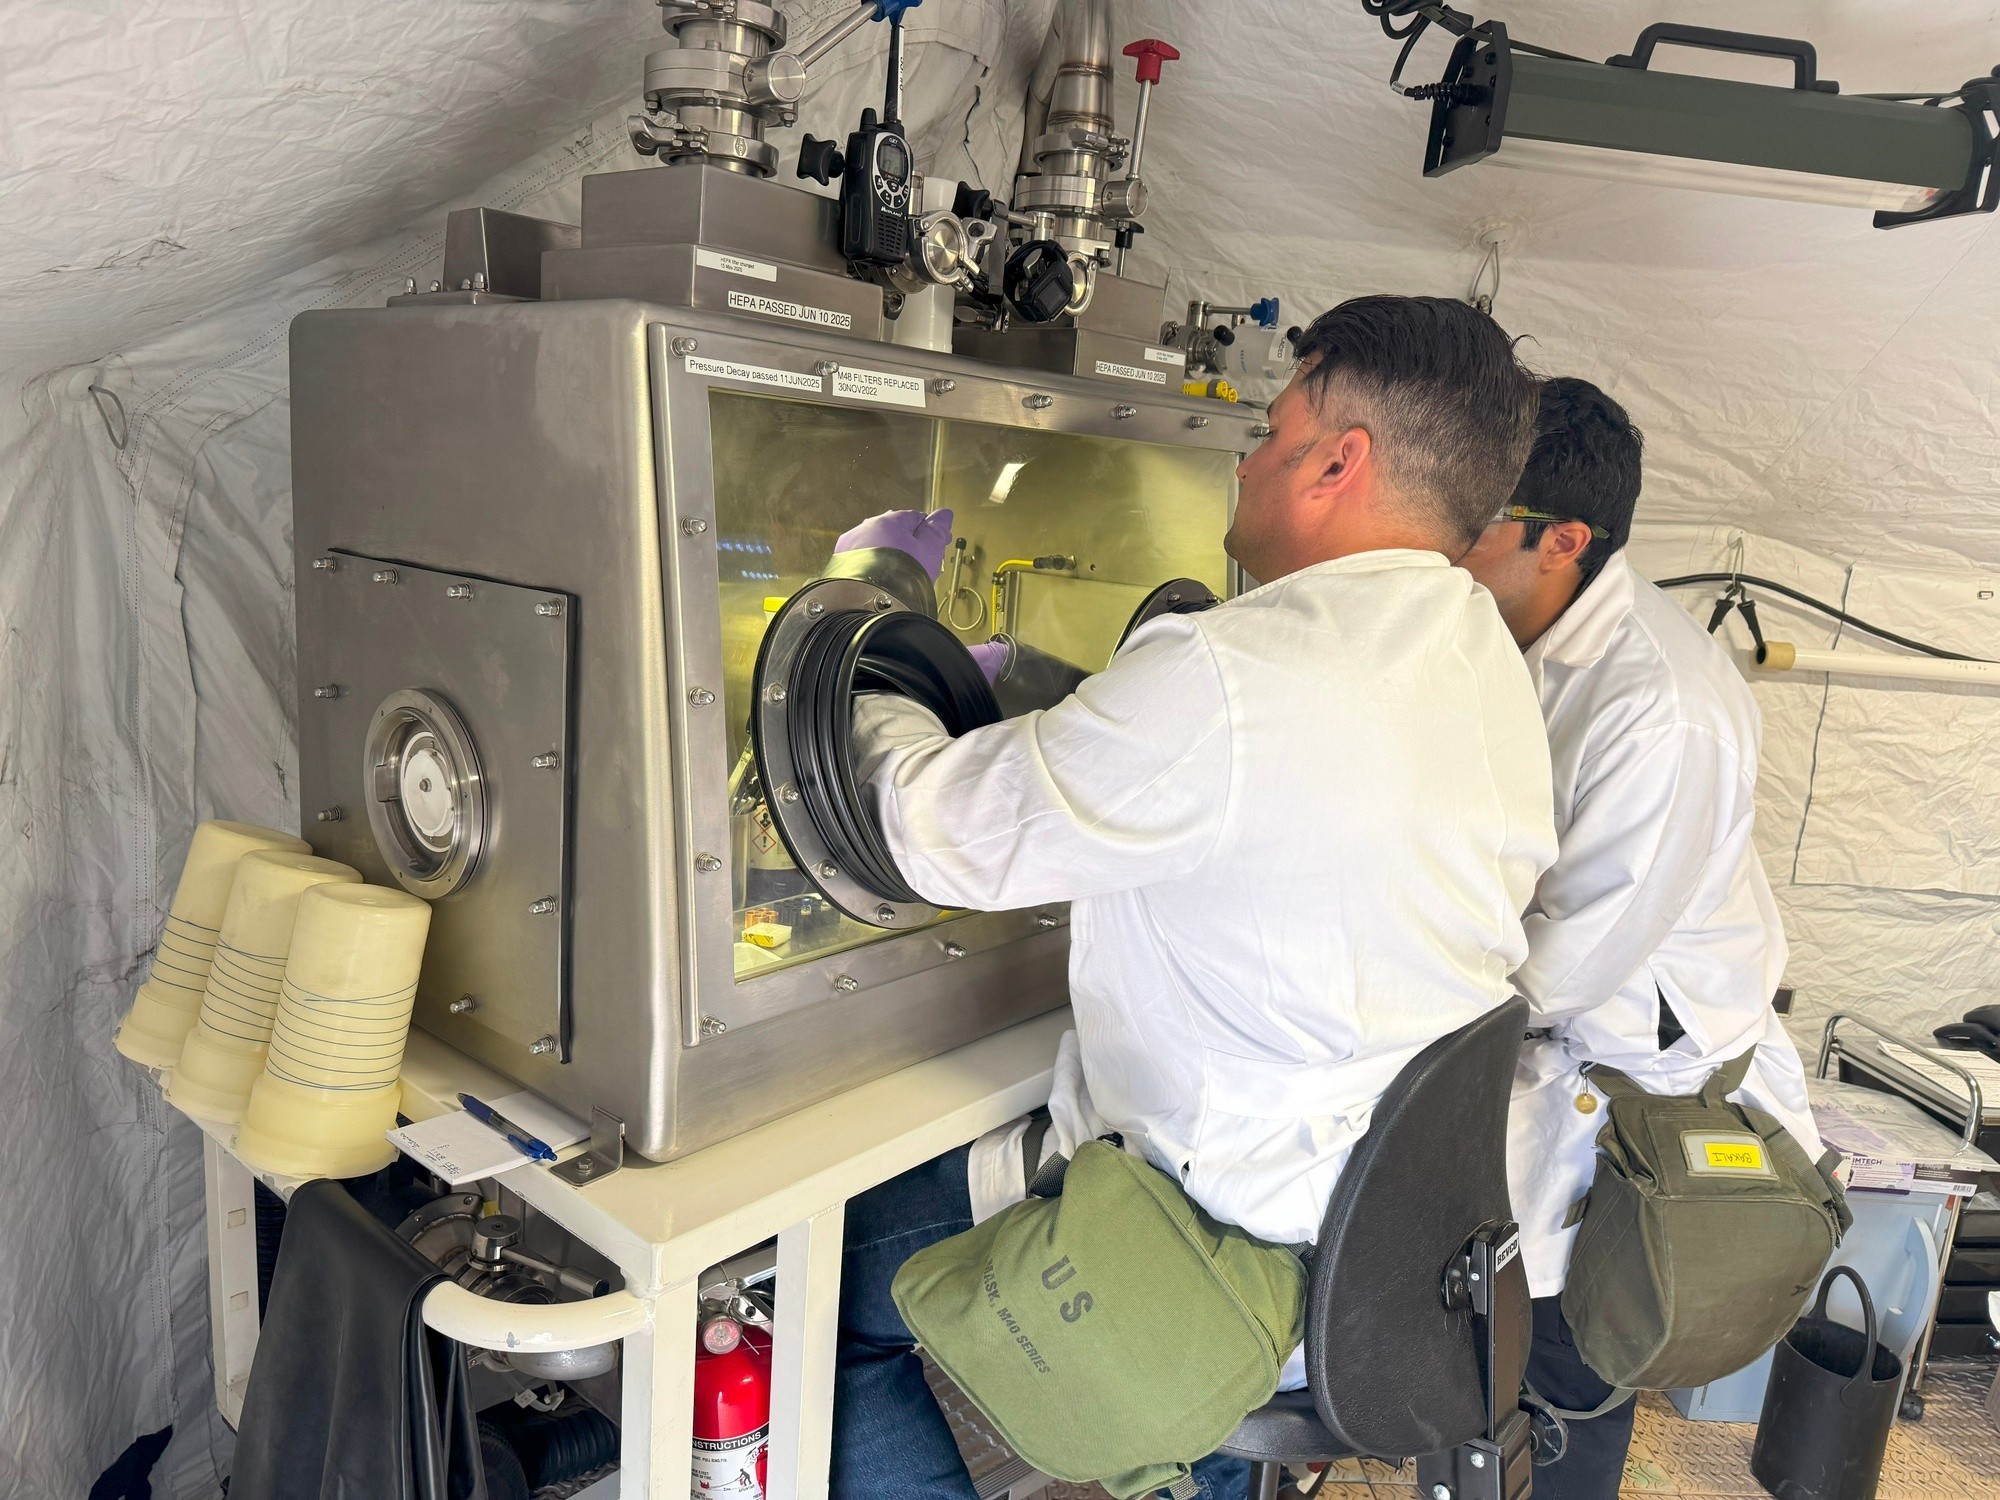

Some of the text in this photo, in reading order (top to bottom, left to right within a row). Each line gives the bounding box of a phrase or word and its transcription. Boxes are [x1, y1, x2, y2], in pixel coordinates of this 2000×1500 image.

[730, 294, 850, 327] HEPA PASSED JUN 10 2025
[689, 360, 820, 388] Pressure Decay passed 11JUN2025
[837, 371, 920, 391] M48 FILTERS REPLACED
[1096, 362, 1165, 383] HEPA PASSED JUN 10 2025
[838, 382, 878, 396] 30NOV2022
[1712, 1152, 1753, 1164] BAKALI
[1852, 1157, 1883, 1166] IMTECH
[1497, 1239, 1518, 1266] BEVCO
[996, 1307, 1021, 1334] M40
[1016, 1334, 1051, 1374] SERIES
[692, 1431, 762, 1450] NSTRUCTIONS
